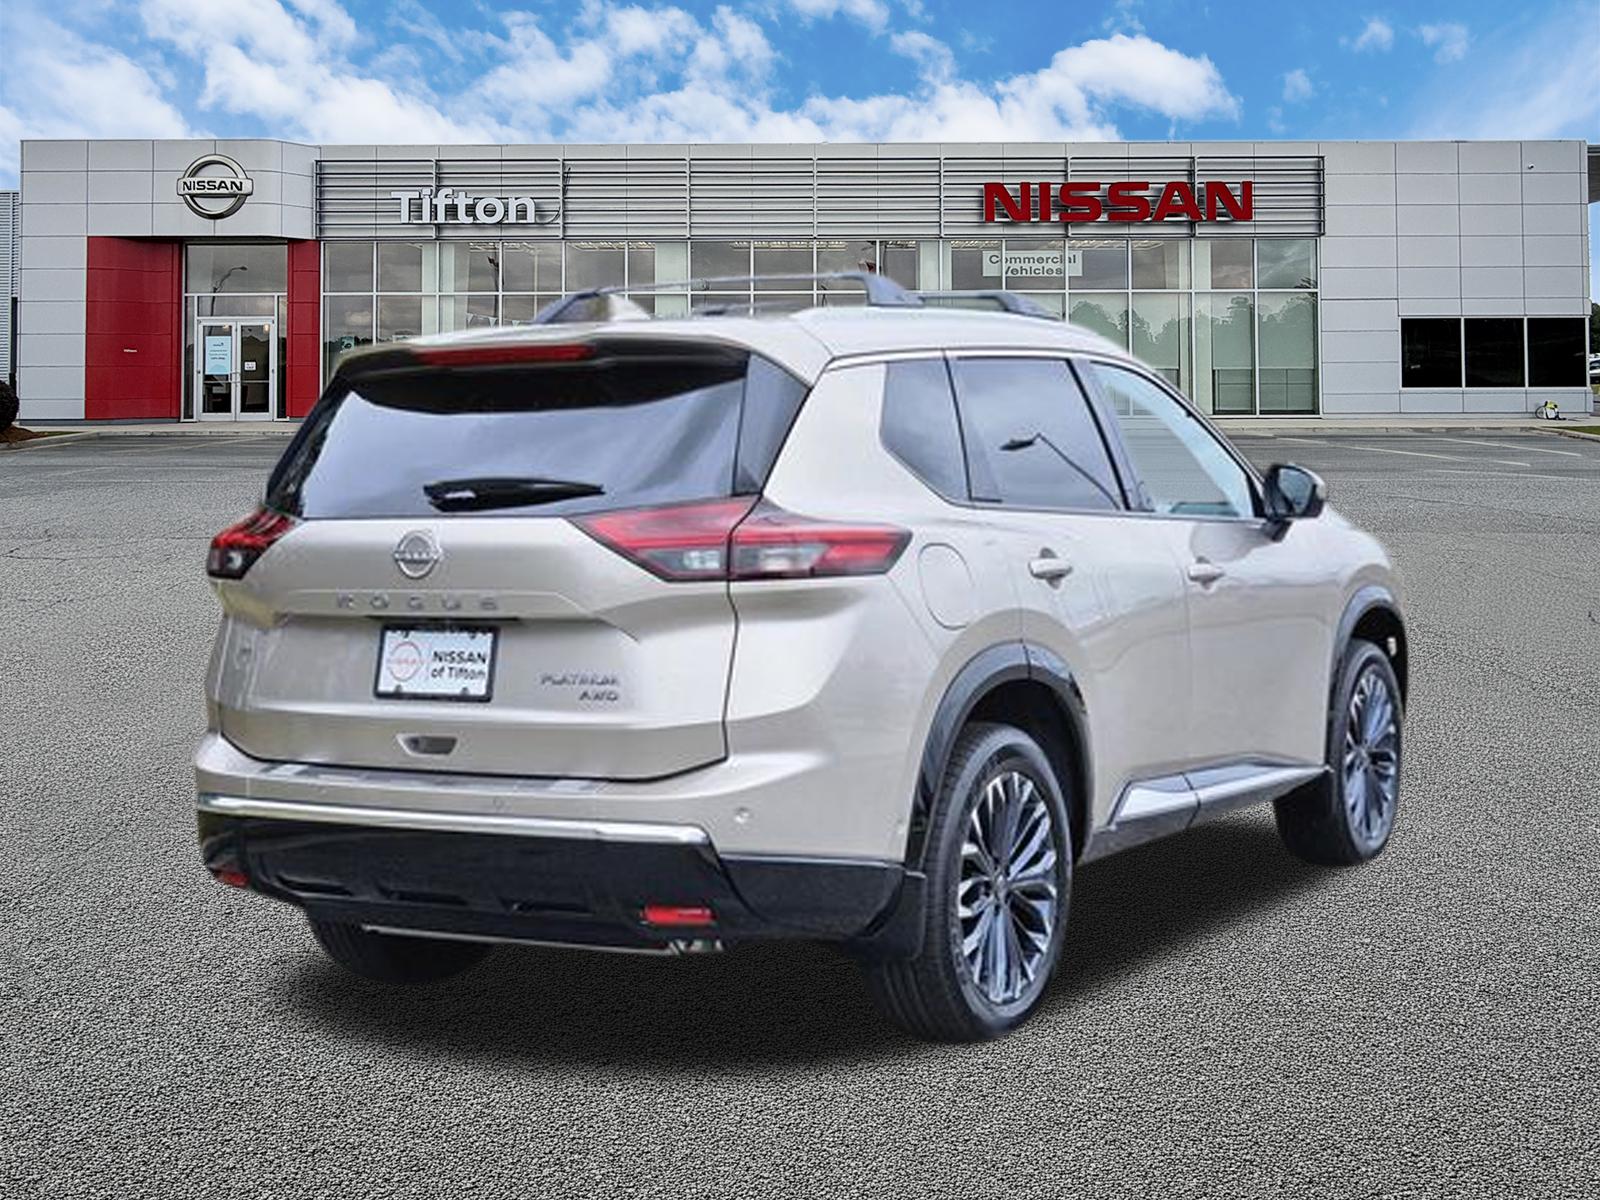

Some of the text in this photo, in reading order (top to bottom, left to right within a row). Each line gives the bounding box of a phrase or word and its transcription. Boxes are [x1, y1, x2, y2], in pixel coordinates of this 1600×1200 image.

[182, 180, 243, 191] NISSAN
[390, 188, 536, 224] Tifton
[983, 181, 1254, 222] NISSAN
[432, 650, 487, 664] NISSAN
[430, 666, 445, 679] of
